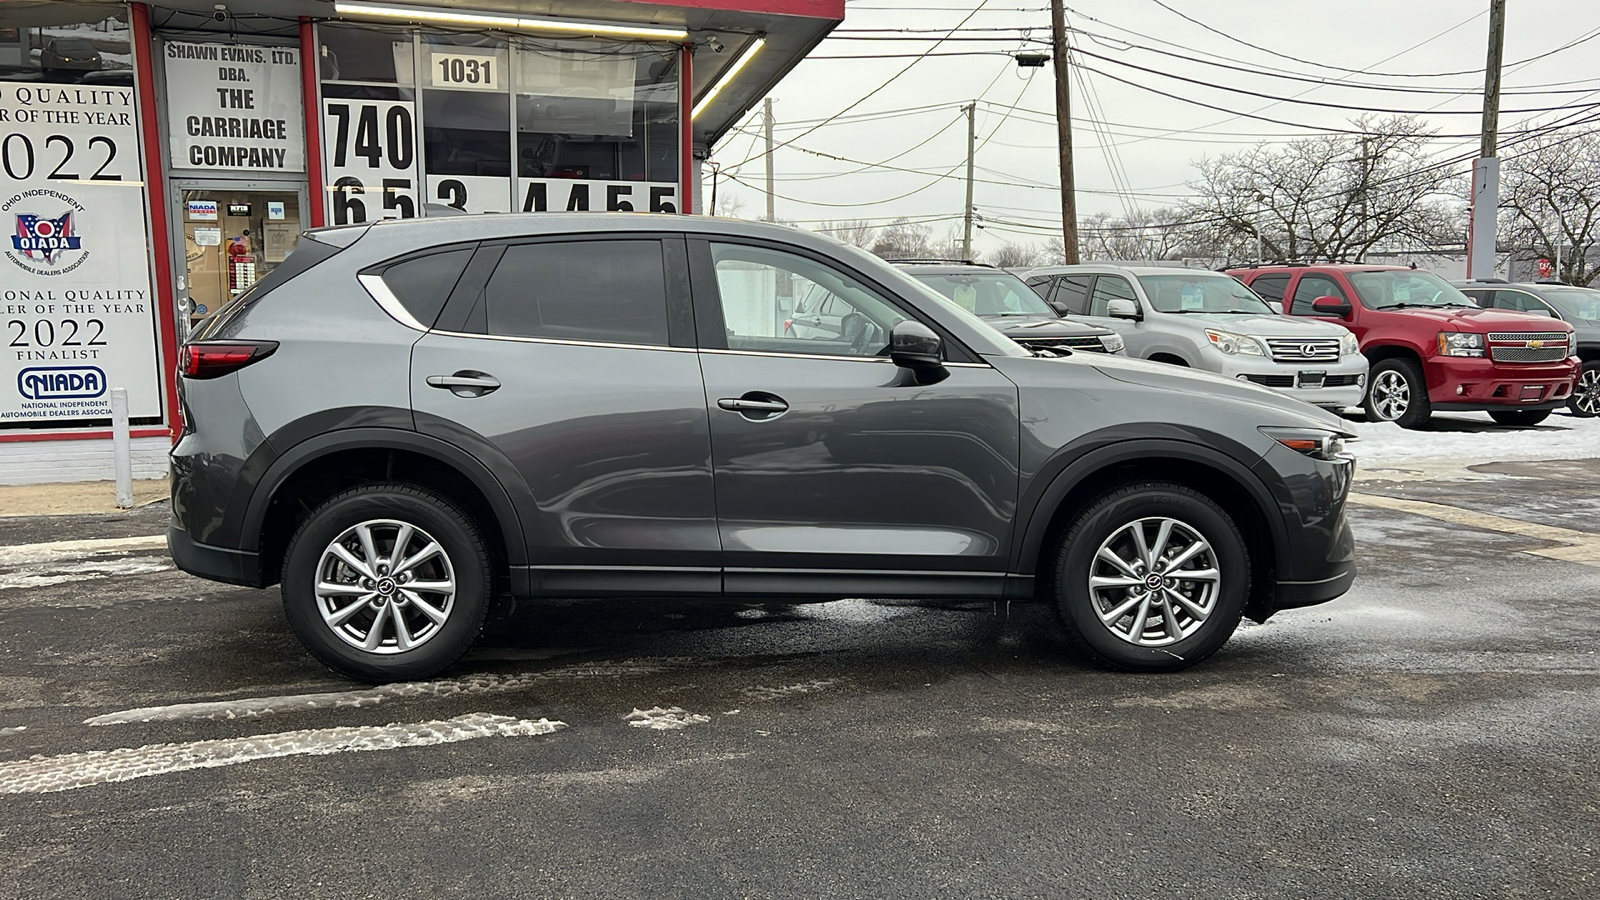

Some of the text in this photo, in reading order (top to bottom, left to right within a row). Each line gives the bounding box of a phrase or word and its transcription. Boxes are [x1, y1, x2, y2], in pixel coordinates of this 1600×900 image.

[167, 44, 297, 65] SHAWN EVANS. LTD.
[218, 67, 250, 82] DBA.
[438, 58, 492, 84] 1031
[15, 87, 131, 106] QUALITY
[217, 88, 254, 109] THE
[14, 109, 39, 122] OF
[43, 110, 79, 124] THE
[84, 112, 131, 126] YEAR
[186, 116, 287, 139] CARRIAGE
[328, 104, 413, 170] 740
[189, 145, 287, 168] COMPANY
[1, 189, 85, 213] OHIO INDEPENDENT
[20, 238, 70, 249] OIADA
[4, 250, 36, 274] AUTOMOBILE
[62, 250, 90, 274] ASSOCIATION
[65, 290, 145, 302] QUALITY
[35, 304, 55, 314] OF
[63, 304, 95, 314] THE
[103, 304, 145, 314] YEAR
[7, 319, 108, 347] 2022
[17, 350, 99, 361] FINALIST
[25, 373, 98, 400] NIADA
[1, 410, 47, 418] AUTOMOBILE
[81, 408, 113, 416] ASSOCIA
[59, 400, 108, 408] INDEPENDENT
